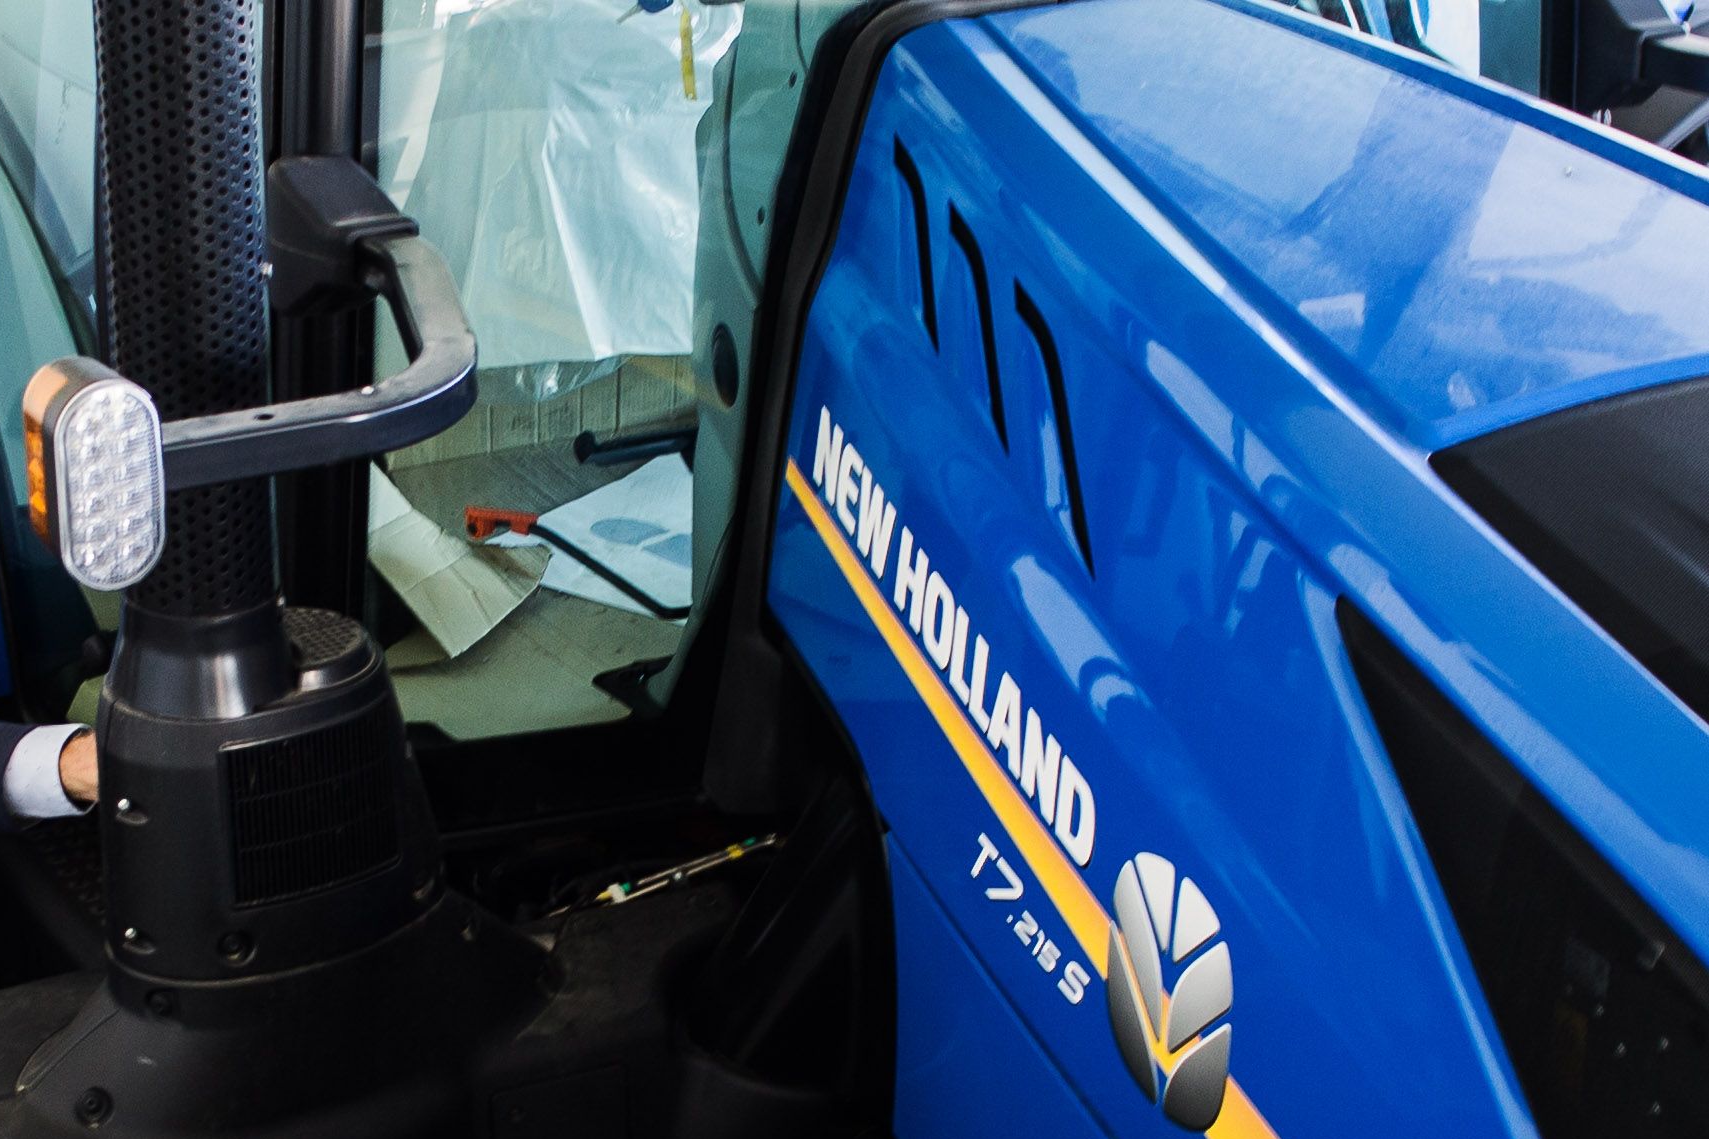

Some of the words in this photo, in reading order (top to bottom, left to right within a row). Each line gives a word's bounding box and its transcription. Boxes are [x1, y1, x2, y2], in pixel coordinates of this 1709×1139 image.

[812, 405, 897, 579] NEW
[894, 526, 1096, 867] HOLLAND
[1057, 960, 1091, 1005] S
